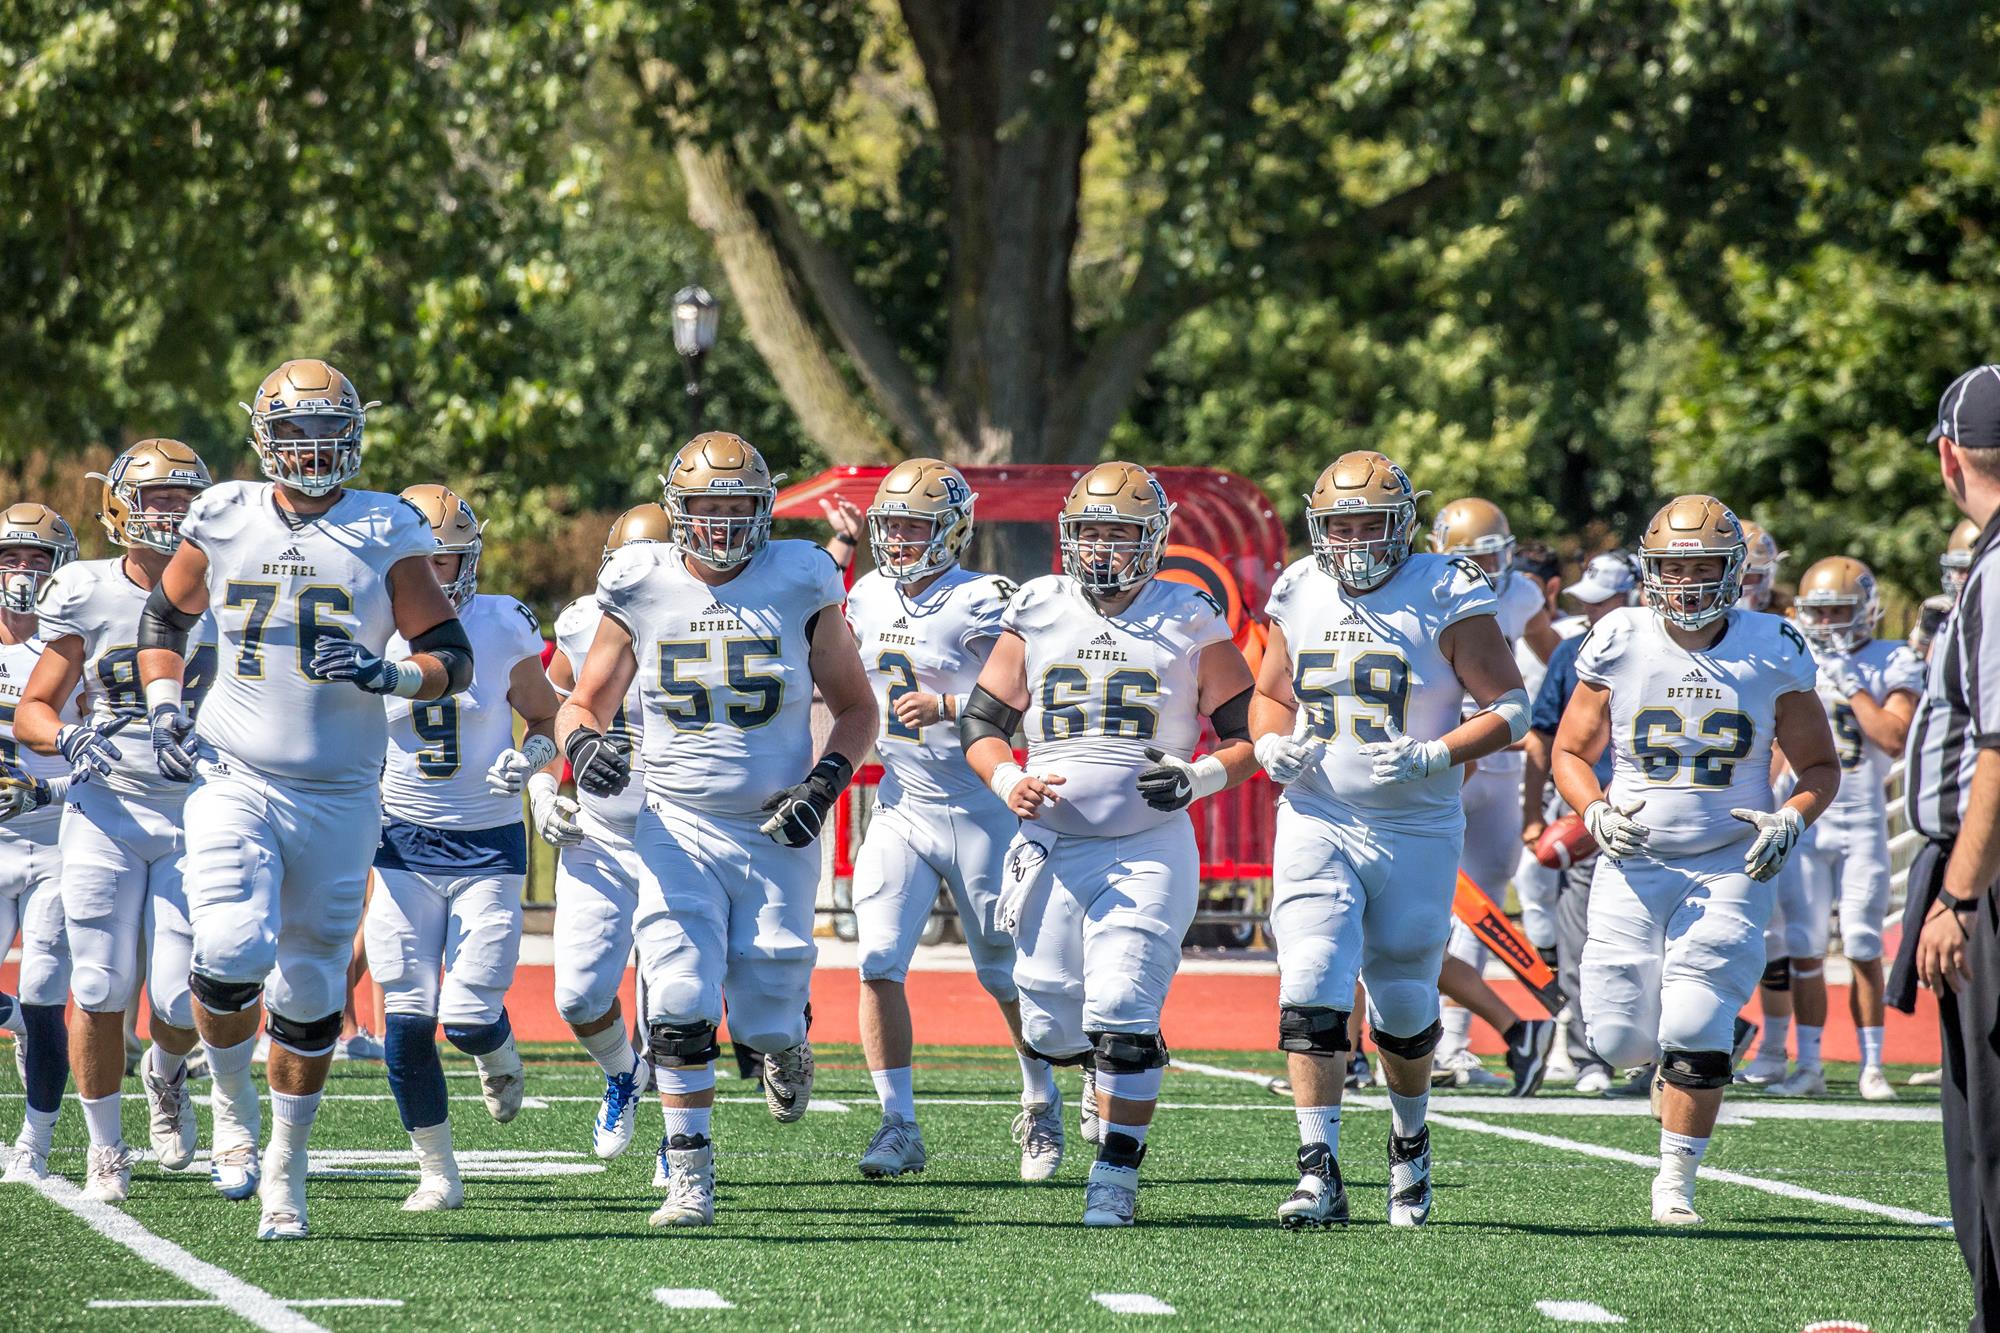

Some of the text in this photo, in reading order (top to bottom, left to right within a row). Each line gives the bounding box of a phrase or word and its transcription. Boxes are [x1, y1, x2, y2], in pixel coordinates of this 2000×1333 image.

[174, 470, 199, 478] BETHEL
[279, 554, 305, 562] adidas
[262, 564, 316, 577] BETHEL
[702, 608, 729, 616] adidas
[224, 580, 353, 684] 76
[690, 619, 743, 632] BETHEL
[880, 632, 916, 646] BETHEL
[1091, 639, 1117, 647] adidas
[1324, 631, 1374, 643] BETHEL
[1077, 649, 1128, 661] BETHEL
[657, 636, 785, 734] 55
[1681, 675, 1708, 683] adidas
[876, 649, 925, 745] 2
[1292, 649, 1412, 745] 59
[1667, 687, 1722, 700] BETHEL
[1040, 664, 1162, 742] 66
[409, 694, 462, 780] 9
[1631, 706, 1756, 790] 62
